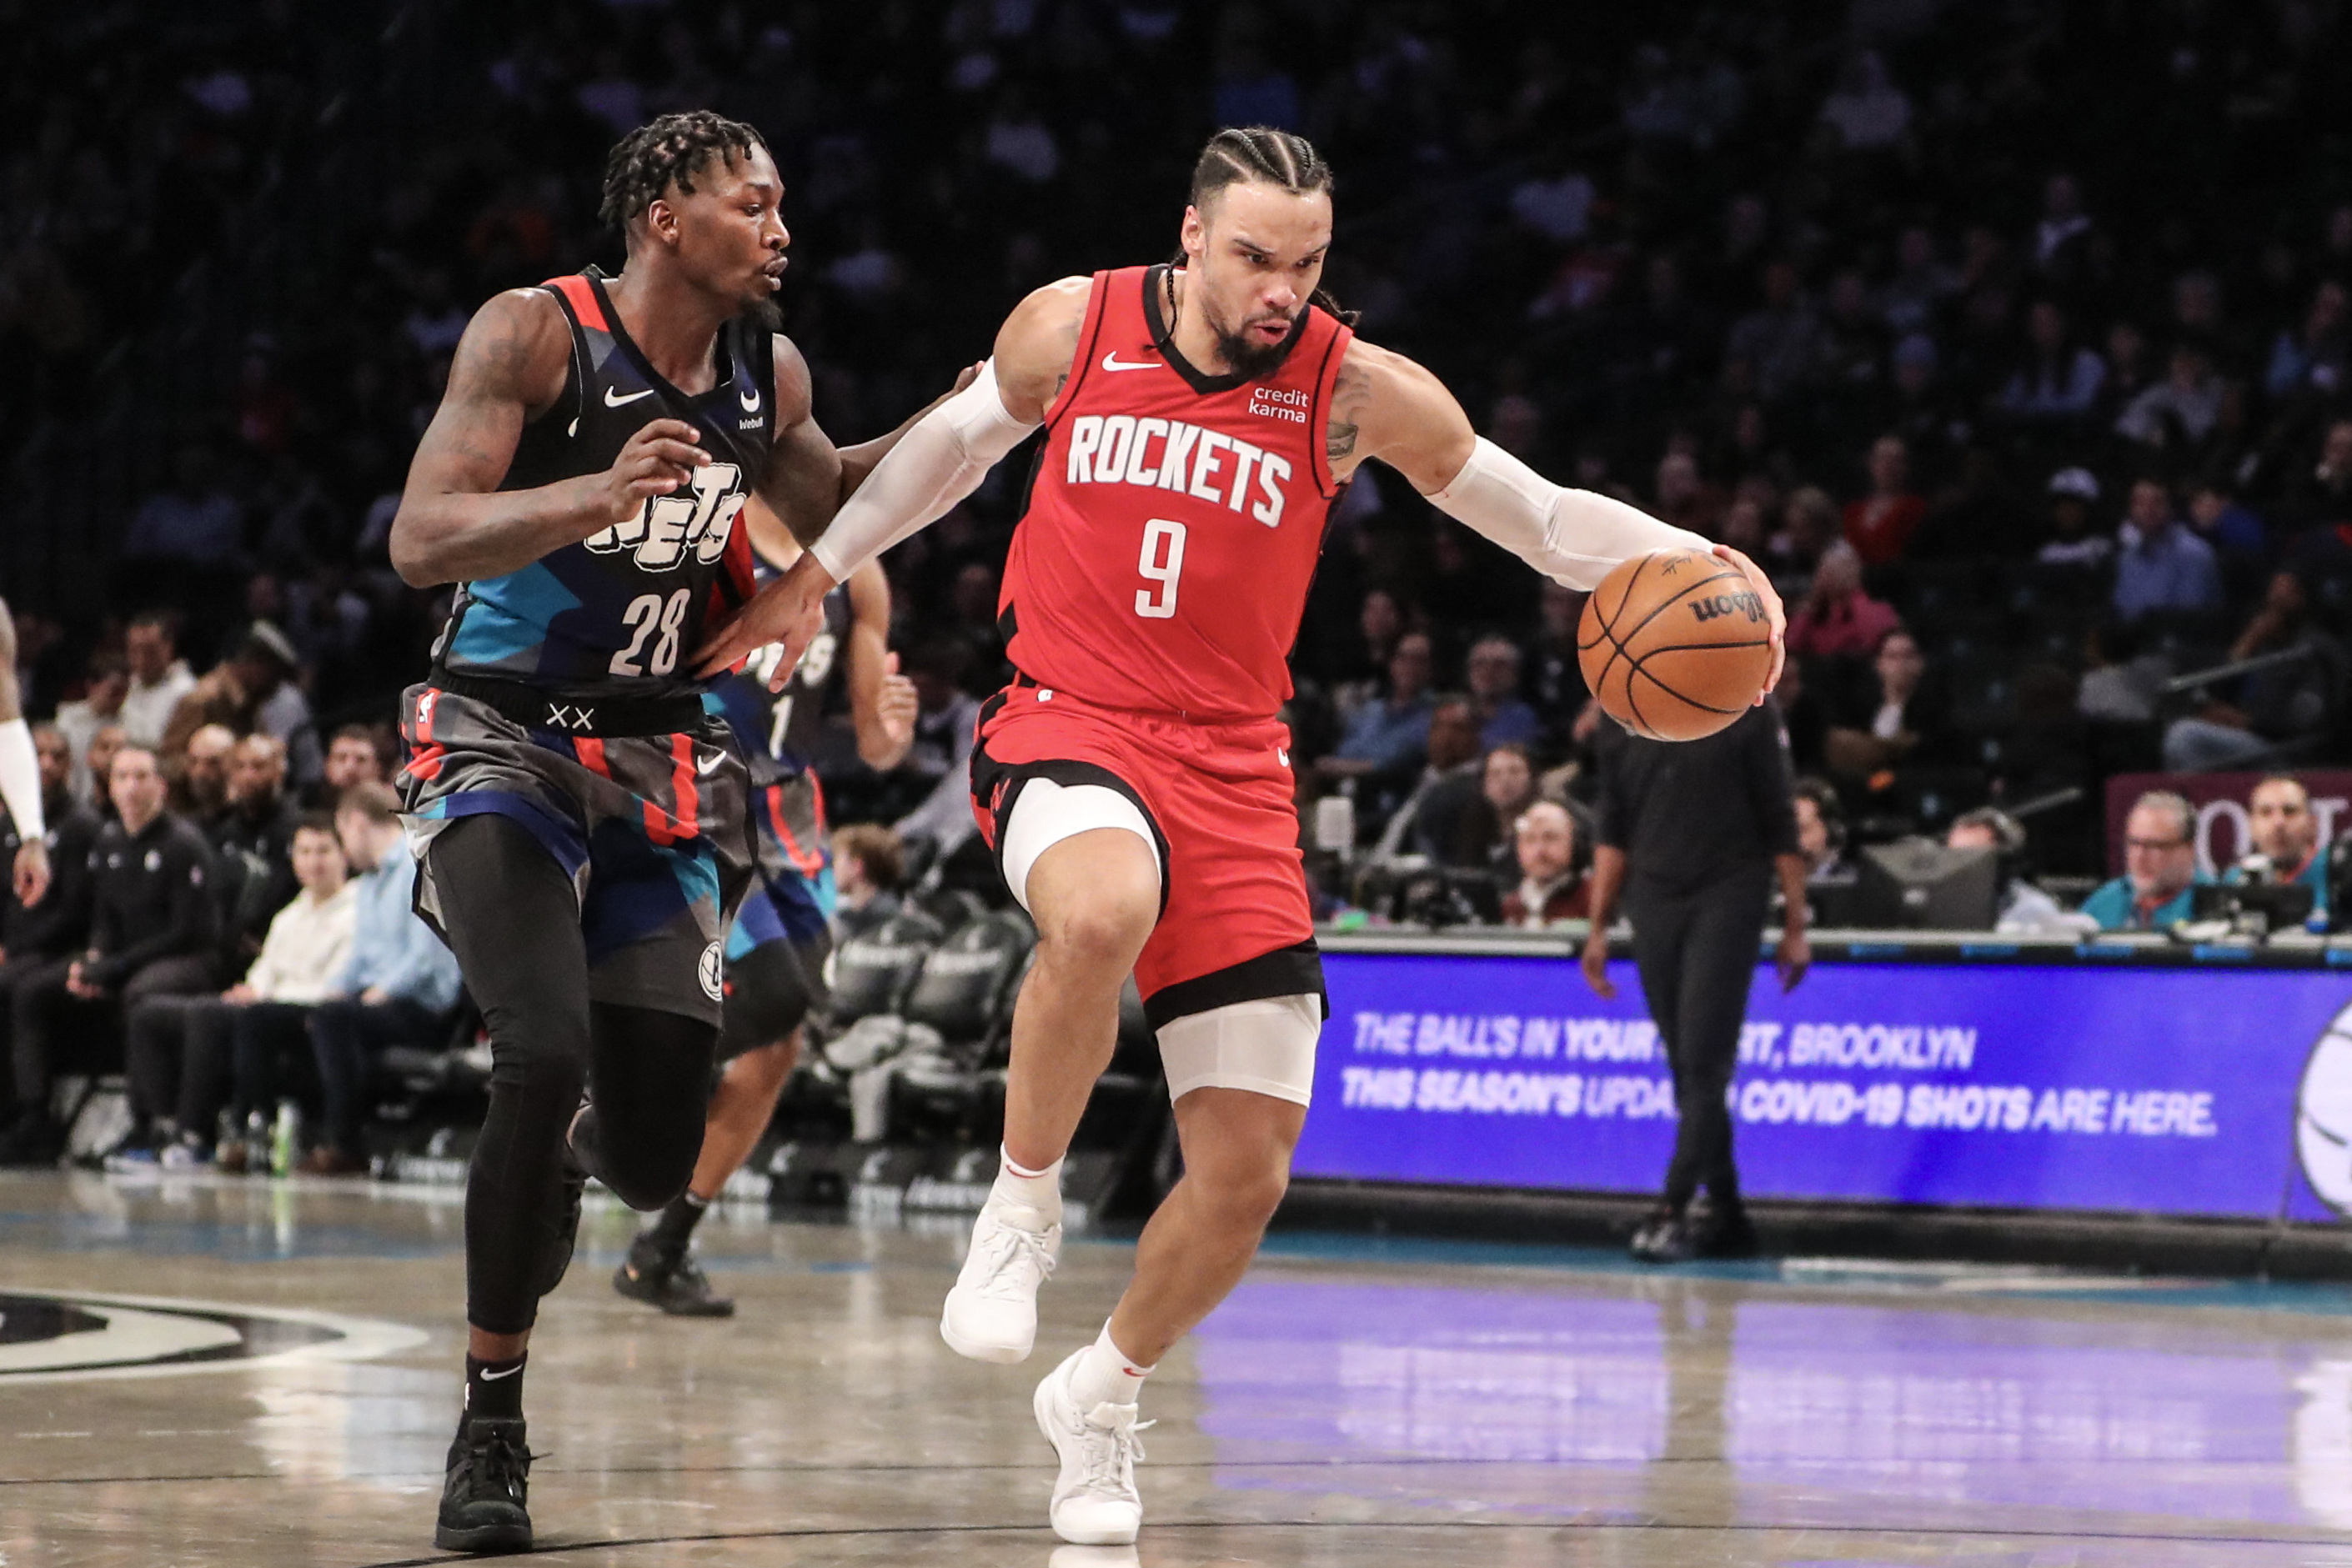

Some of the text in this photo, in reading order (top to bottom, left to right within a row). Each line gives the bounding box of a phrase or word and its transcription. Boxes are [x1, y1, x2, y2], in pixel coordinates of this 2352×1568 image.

[739, 416, 764, 430] Webull
[1248, 398, 1306, 423] karma
[1254, 387, 1309, 408] credit
[1067, 414, 1291, 529] ROCKETS
[1134, 518, 1187, 619] 9
[608, 588, 692, 677] 28
[1687, 590, 1771, 623] ilson
[1353, 1011, 1416, 1055] THE
[1522, 1017, 1561, 1058] IN
[1564, 1018, 1659, 1062] YOUR
[1788, 1023, 1978, 1070] BROOKLYN
[1341, 1065, 2219, 1137] THIS SEASON'S UPDA COVID-19 SHOTS ARE HERE.
